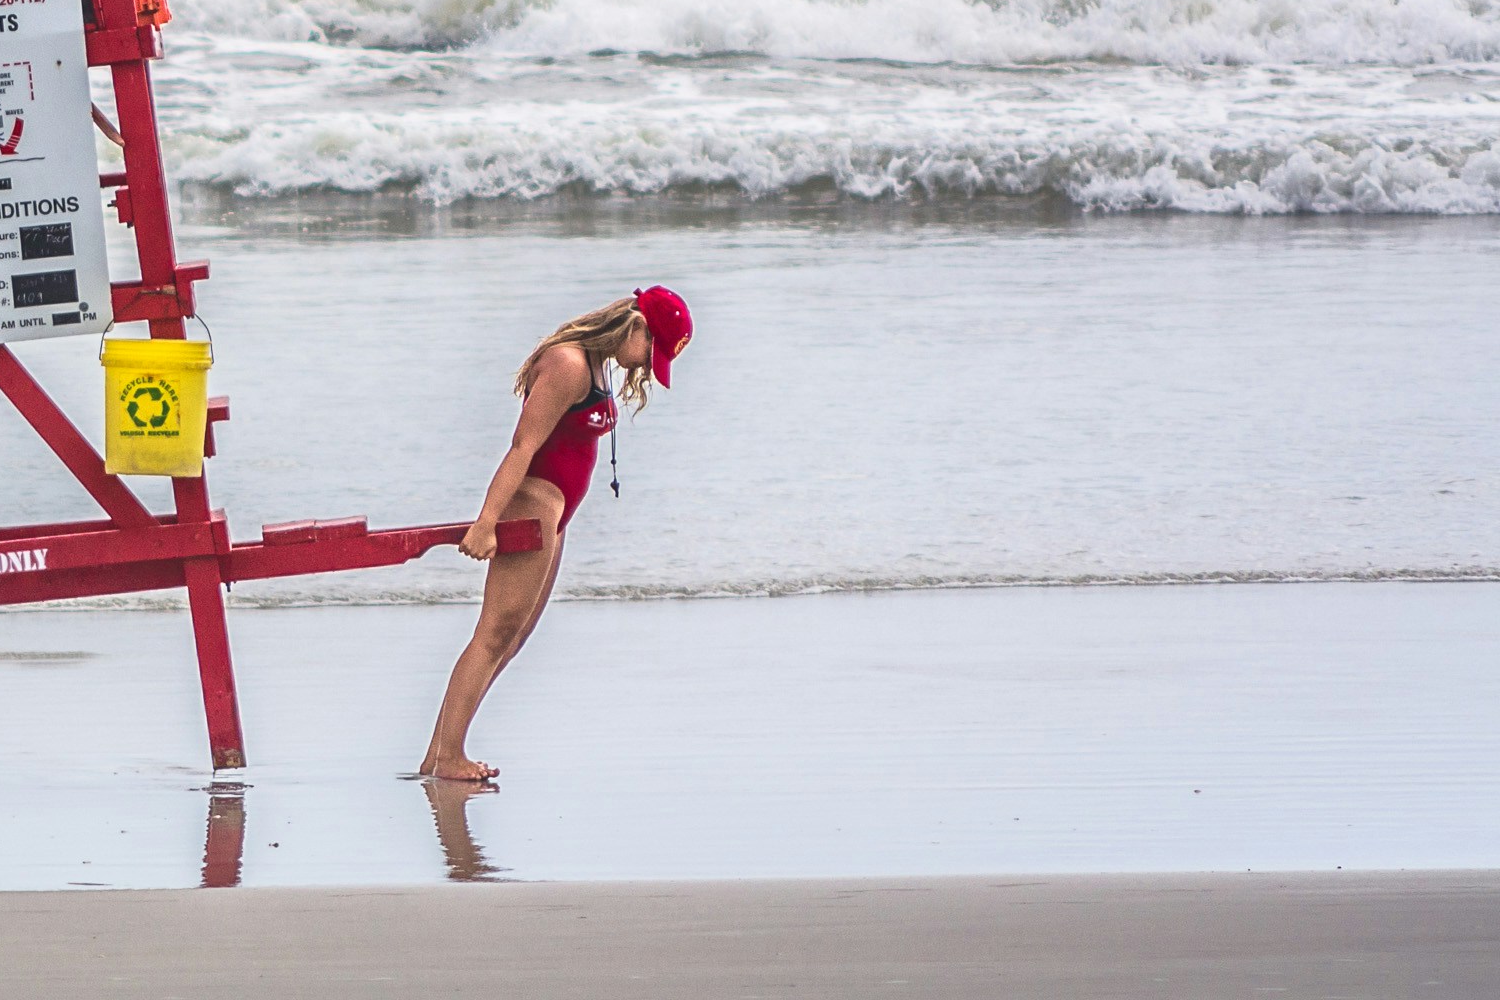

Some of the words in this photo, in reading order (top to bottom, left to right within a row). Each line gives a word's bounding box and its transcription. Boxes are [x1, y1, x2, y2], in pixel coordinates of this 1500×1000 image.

[1, 298, 10, 306] #:
[82, 312, 97, 321] PM
[0, 320, 16, 330] AM
[19, 318, 46, 328] UNTIL
[120, 376, 154, 402] RECYCLE
[158, 380, 179, 402] HERE
